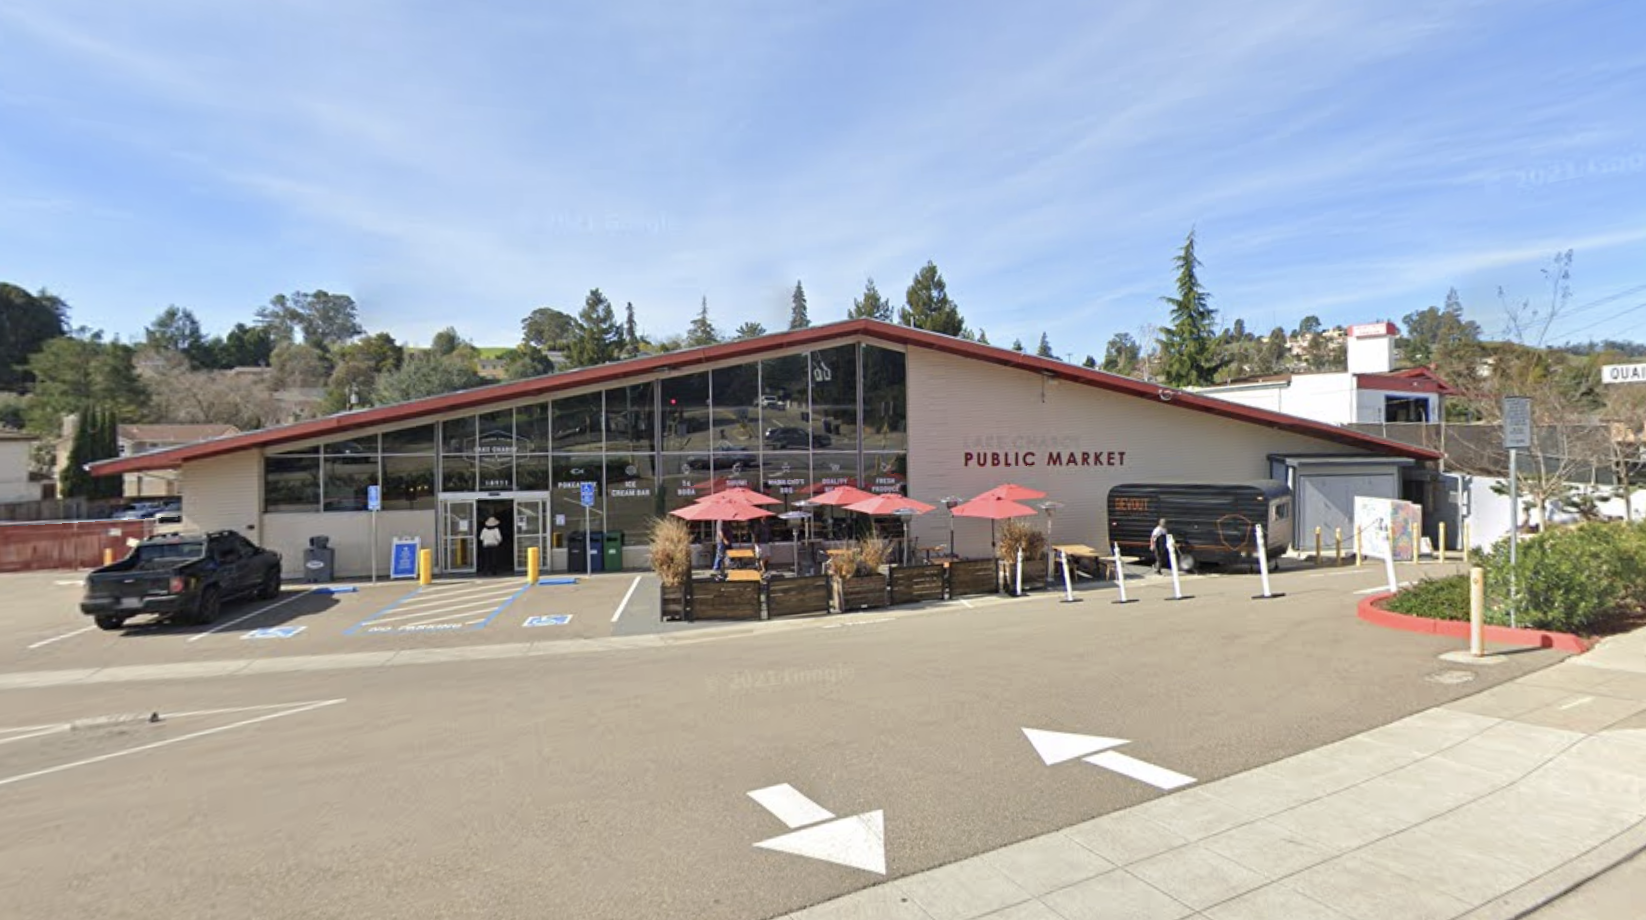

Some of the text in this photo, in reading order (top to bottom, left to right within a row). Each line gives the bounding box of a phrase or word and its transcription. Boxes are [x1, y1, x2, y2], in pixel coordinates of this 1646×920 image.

[964, 451, 1126, 467] PUBLIC MARKET
[611, 488, 651, 498] CREAM BAR
[398, 623, 462, 632] PARKING
